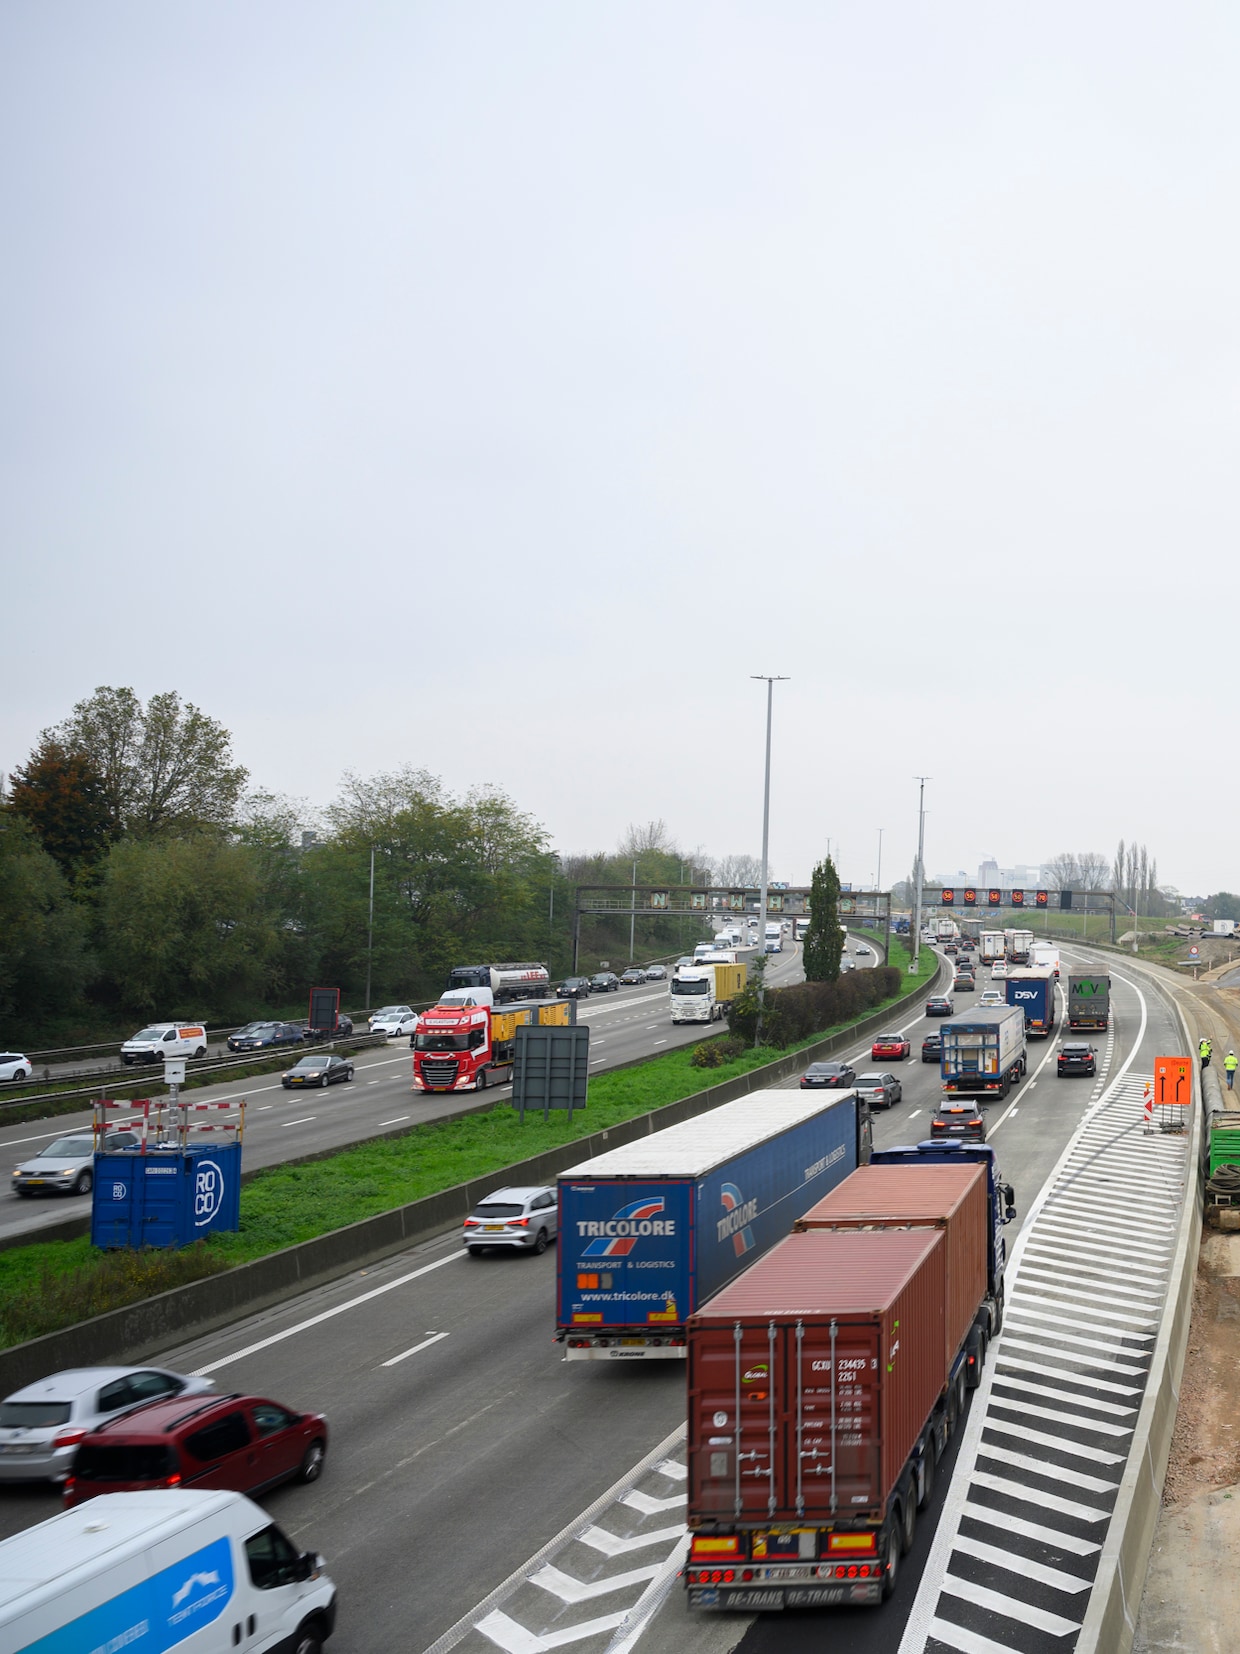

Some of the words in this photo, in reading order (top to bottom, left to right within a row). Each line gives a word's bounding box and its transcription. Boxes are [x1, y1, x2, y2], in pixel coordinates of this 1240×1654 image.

[1014, 991, 1039, 1000] DSV
[804, 1157, 826, 1180] TRANSPORT
[717, 1197, 757, 1242] TRICOLORE
[576, 1220, 676, 1237] TRICOLORE
[576, 1261, 622, 1270] TRANSPORT
[626, 1261, 634, 1269] &
[635, 1260, 676, 1269] LOGISTICS
[580, 1291, 675, 1302] www.tricolore.dk
[838, 1358, 867, 1370] 234435
[726, 1590, 784, 1606] BE-TRANS
[787, 1588, 844, 1604] BE-TRANS
